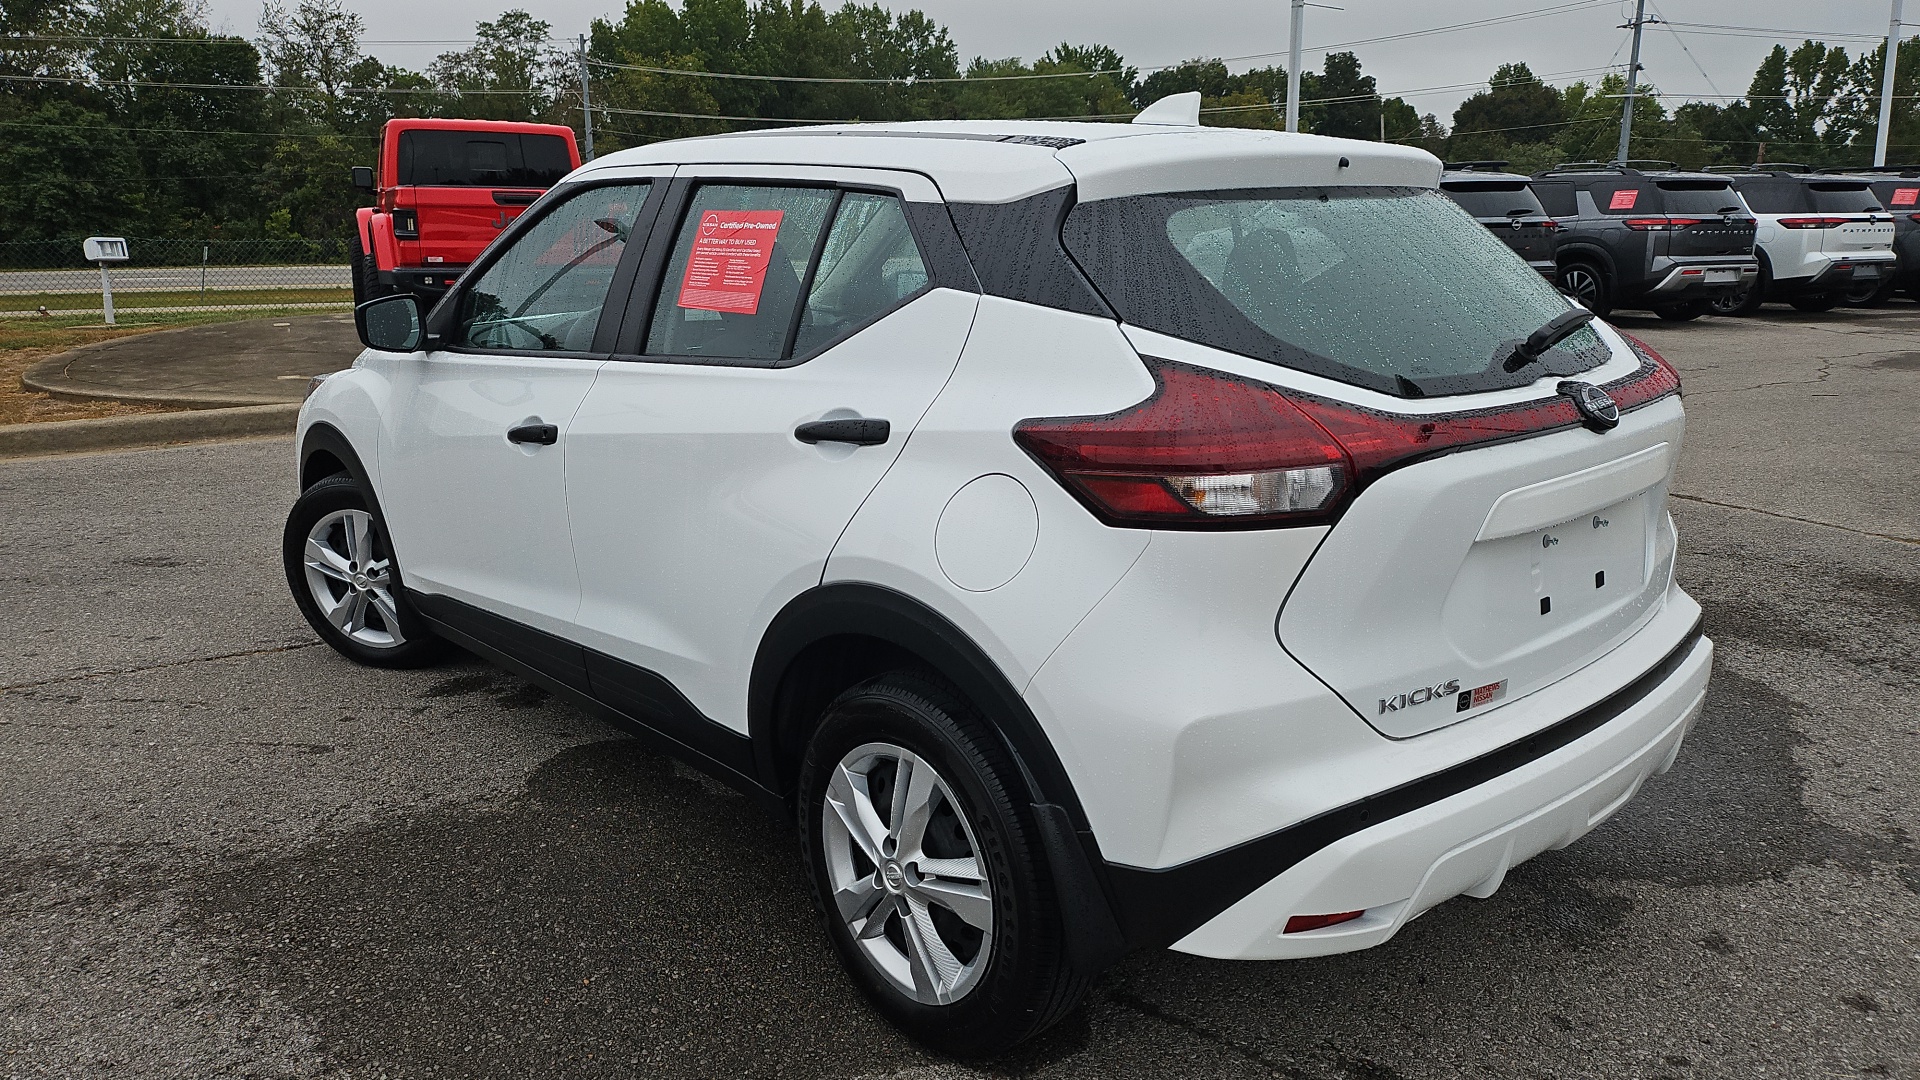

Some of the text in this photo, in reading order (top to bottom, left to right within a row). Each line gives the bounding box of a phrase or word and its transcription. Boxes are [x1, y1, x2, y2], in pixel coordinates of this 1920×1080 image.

[744, 222, 777, 230] Pre-Owned
[1378, 677, 1460, 715] KICKS
[1473, 692, 1493, 703] NISSAN
